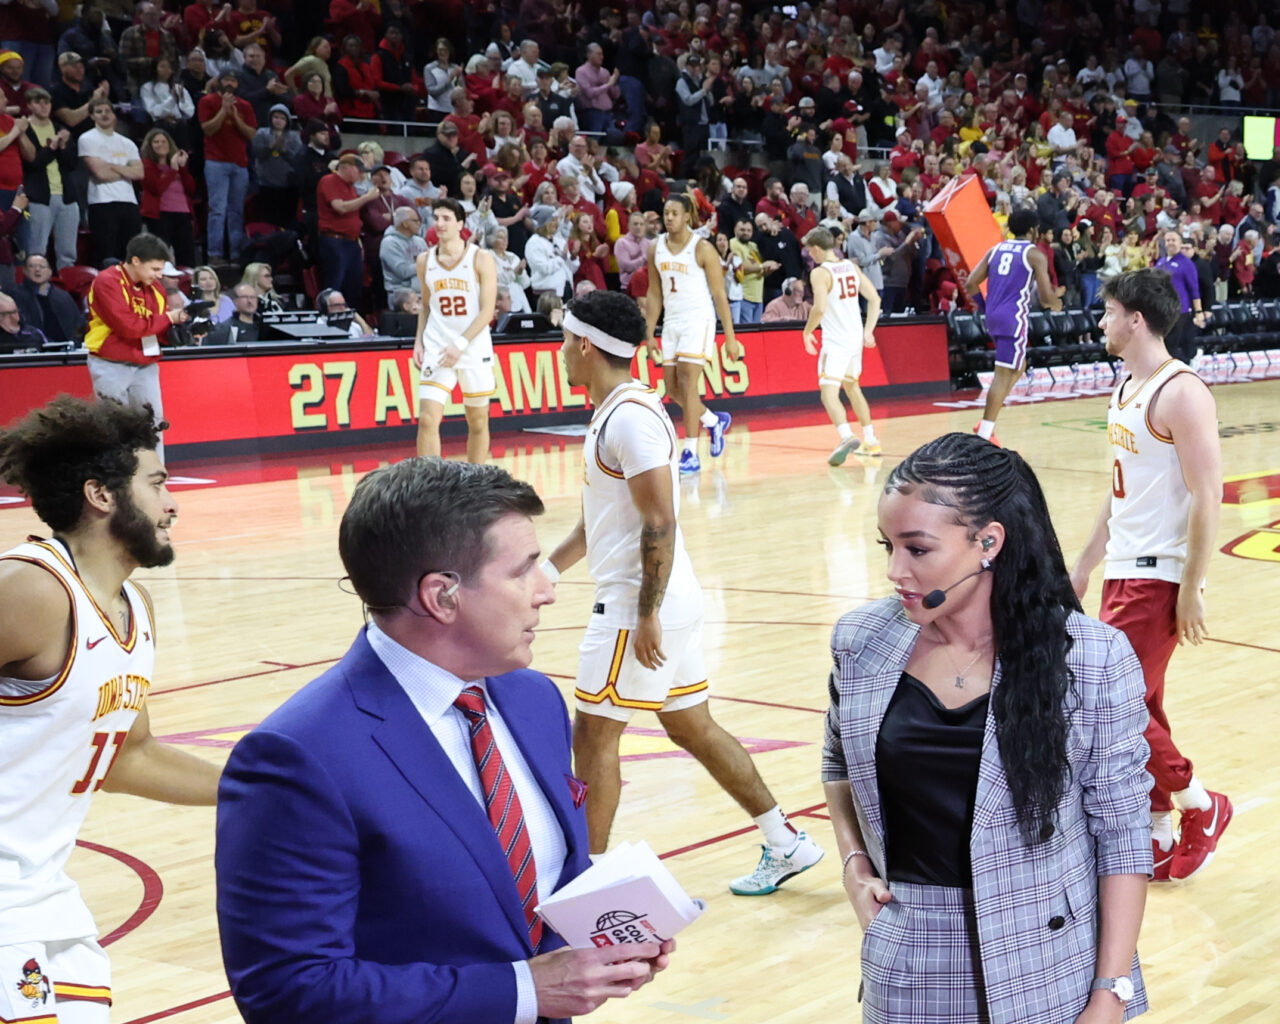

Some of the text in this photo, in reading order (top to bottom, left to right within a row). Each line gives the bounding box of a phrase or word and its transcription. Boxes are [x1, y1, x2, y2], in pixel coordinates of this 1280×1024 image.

[998, 253, 1014, 275] 8
[669, 276, 678, 293] 1
[838, 275, 858, 300] 15
[439, 296, 467, 316] 22
[288, 362, 357, 428] 27
[92, 674, 151, 722] IOWA STAT
[624, 925, 652, 944] COLL
